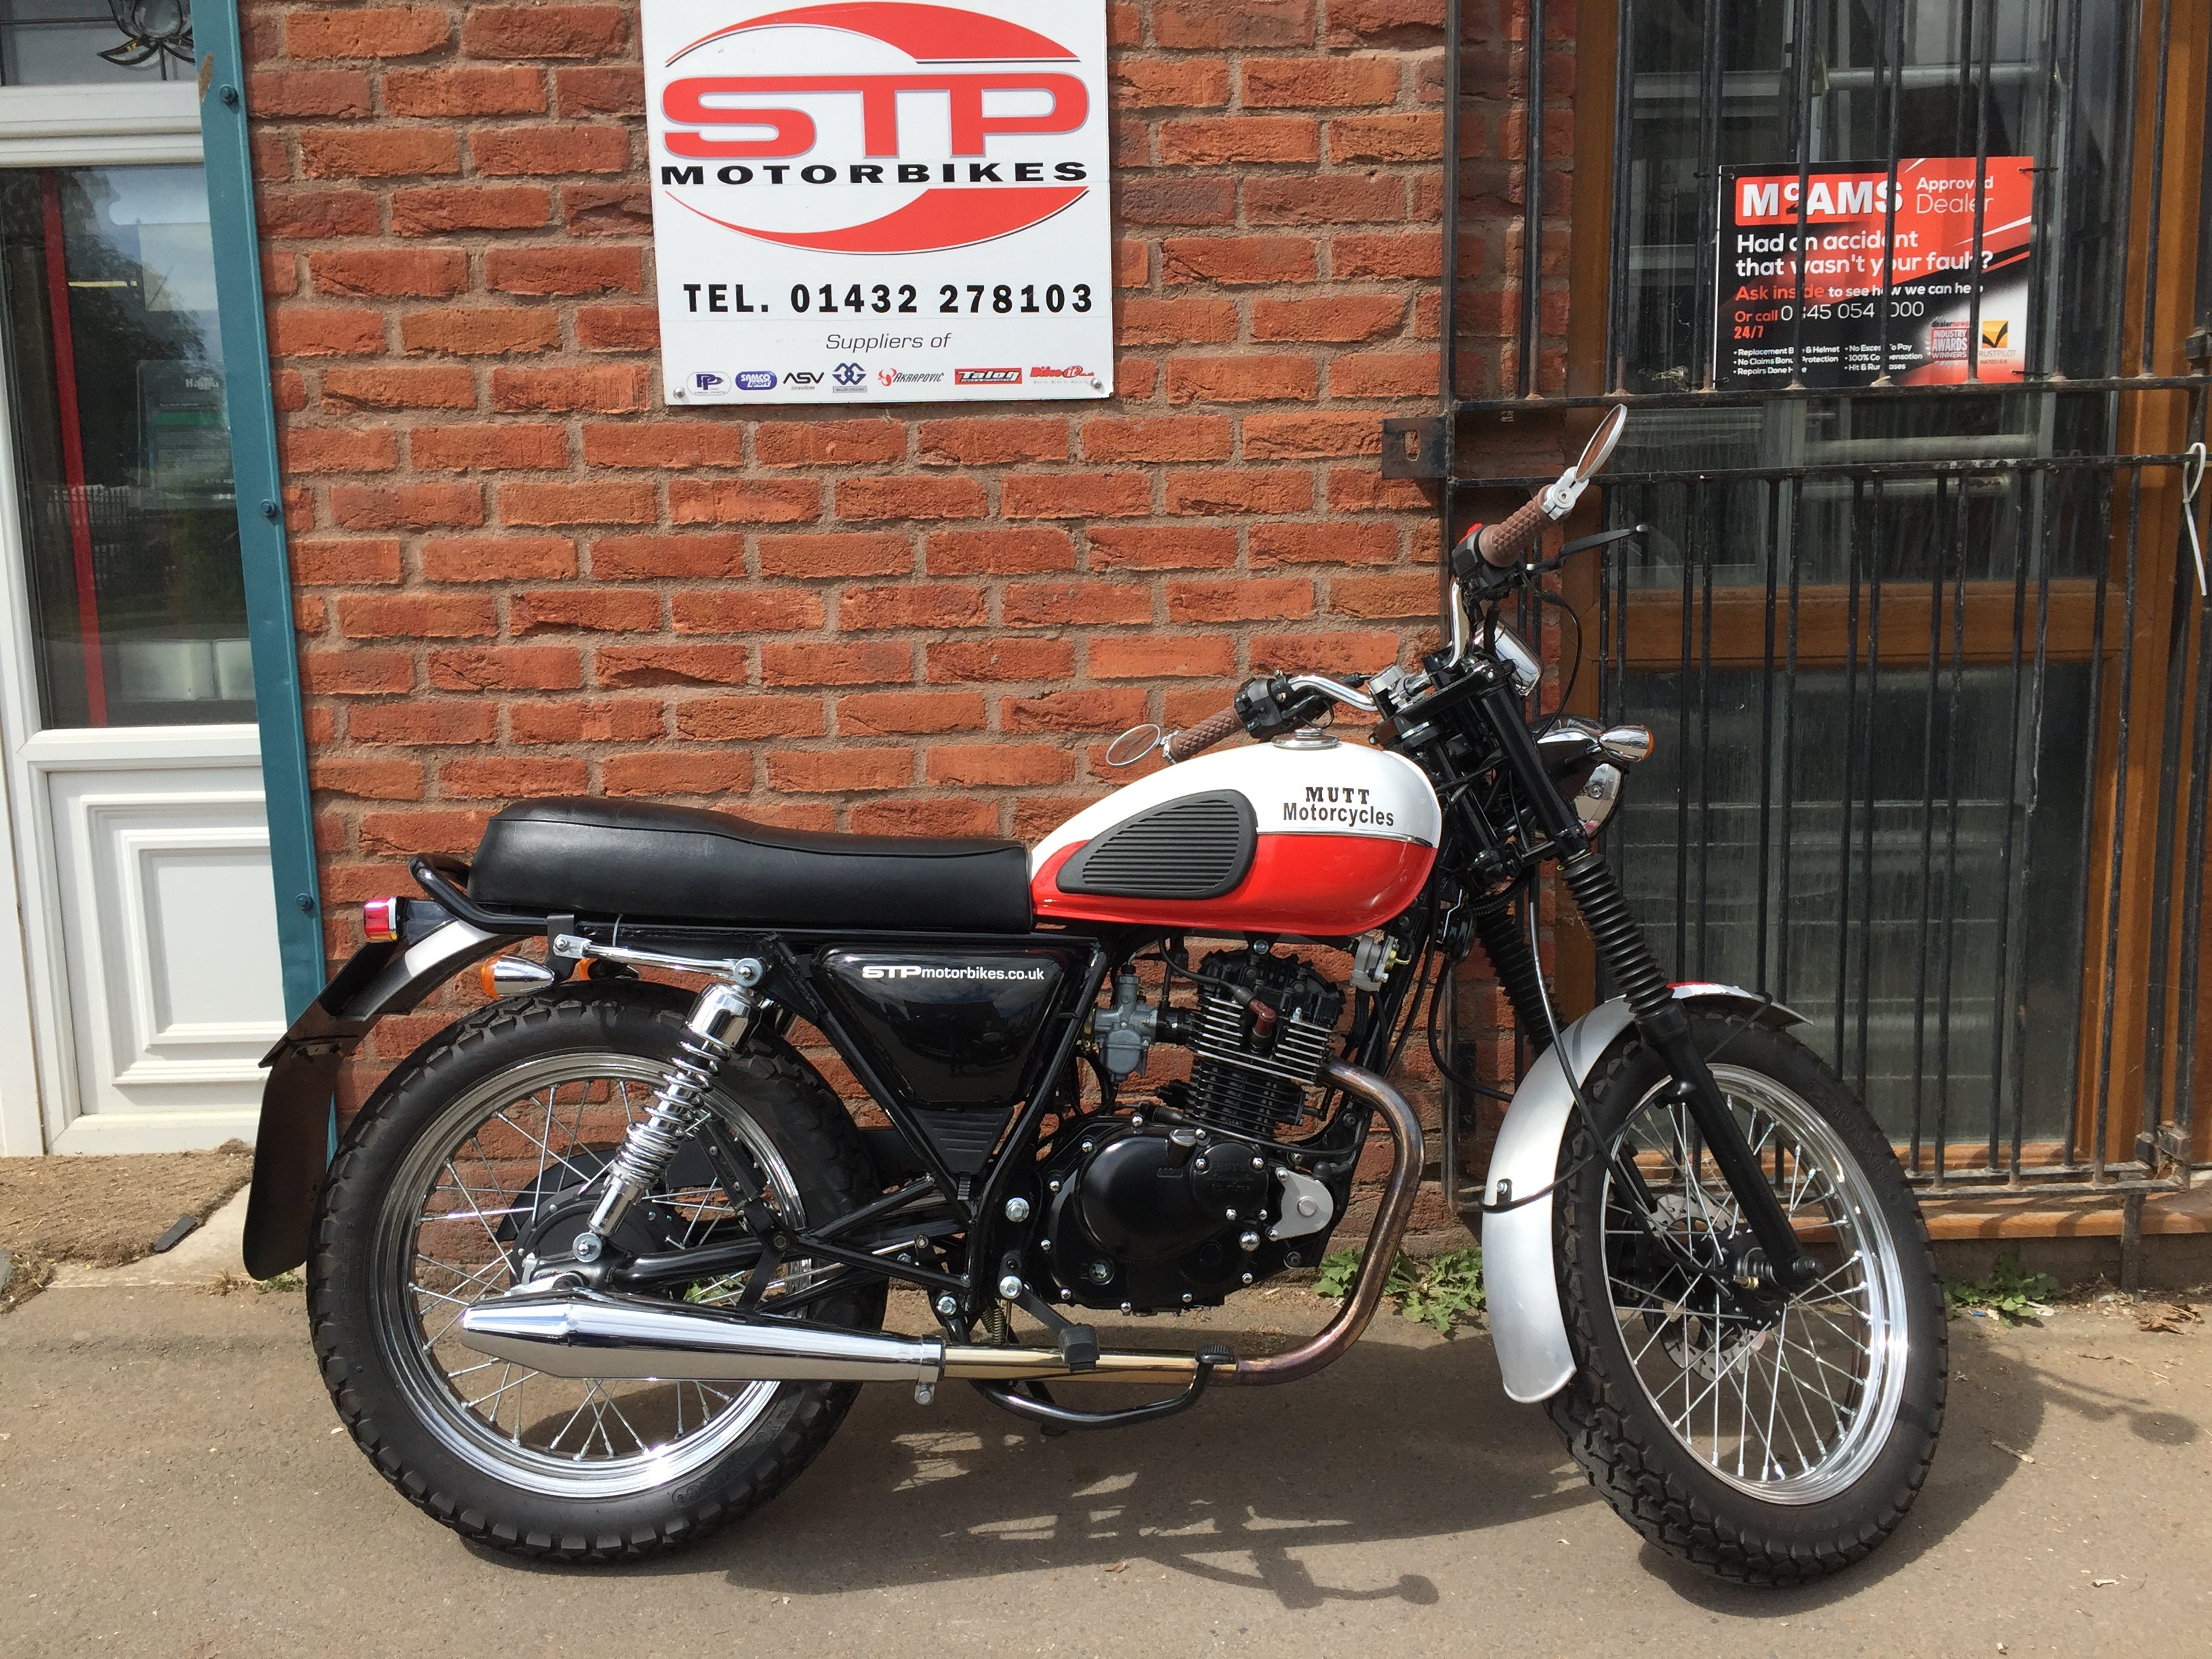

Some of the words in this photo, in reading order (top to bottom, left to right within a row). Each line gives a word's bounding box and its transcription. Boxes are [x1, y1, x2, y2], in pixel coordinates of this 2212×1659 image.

[661, 70, 1090, 160] STP
[661, 162, 1088, 185] MOTORBIKES
[1916, 176, 1994, 193] Approvd
[1737, 232, 1784, 253] Had
[1736, 257, 1784, 276] that
[1926, 249, 1994, 270] faul?
[683, 283, 770, 314] TEL.
[790, 283, 918, 314] 01432
[939, 283, 1092, 313] 278103
[1735, 285, 1768, 301] Ask
[1773, 284, 1824, 300] insde
[1828, 286, 1843, 298] to
[1845, 285, 1869, 298] see
[1904, 283, 1925, 295] we
[1928, 281, 1952, 295] can
[1734, 310, 1753, 323] Or
[1755, 309, 1778, 322] call
[1780, 304, 1832, 321] 045
[1837, 302, 1875, 319] 054
[1734, 325, 1764, 340] 24/7
[1933, 329, 1967, 337] INDUSTRY
[826, 333, 924, 353] Suppliers
[930, 333, 951, 348] of
[1738, 348, 1788, 357] Replacement
[1813, 345, 1841, 353] Helmet
[1898, 343, 1912, 351] Pay
[1932, 337, 1967, 351] AWARDS
[1749, 357, 1775, 365] Claims
[1849, 354, 1869, 362] 100%
[783, 372, 825, 384] ASV
[957, 370, 1020, 382] Talon
[1737, 367, 1767, 376] Repairs
[1305, 786, 1370, 804] MUTT
[1283, 802, 1395, 827] Motorcycles
